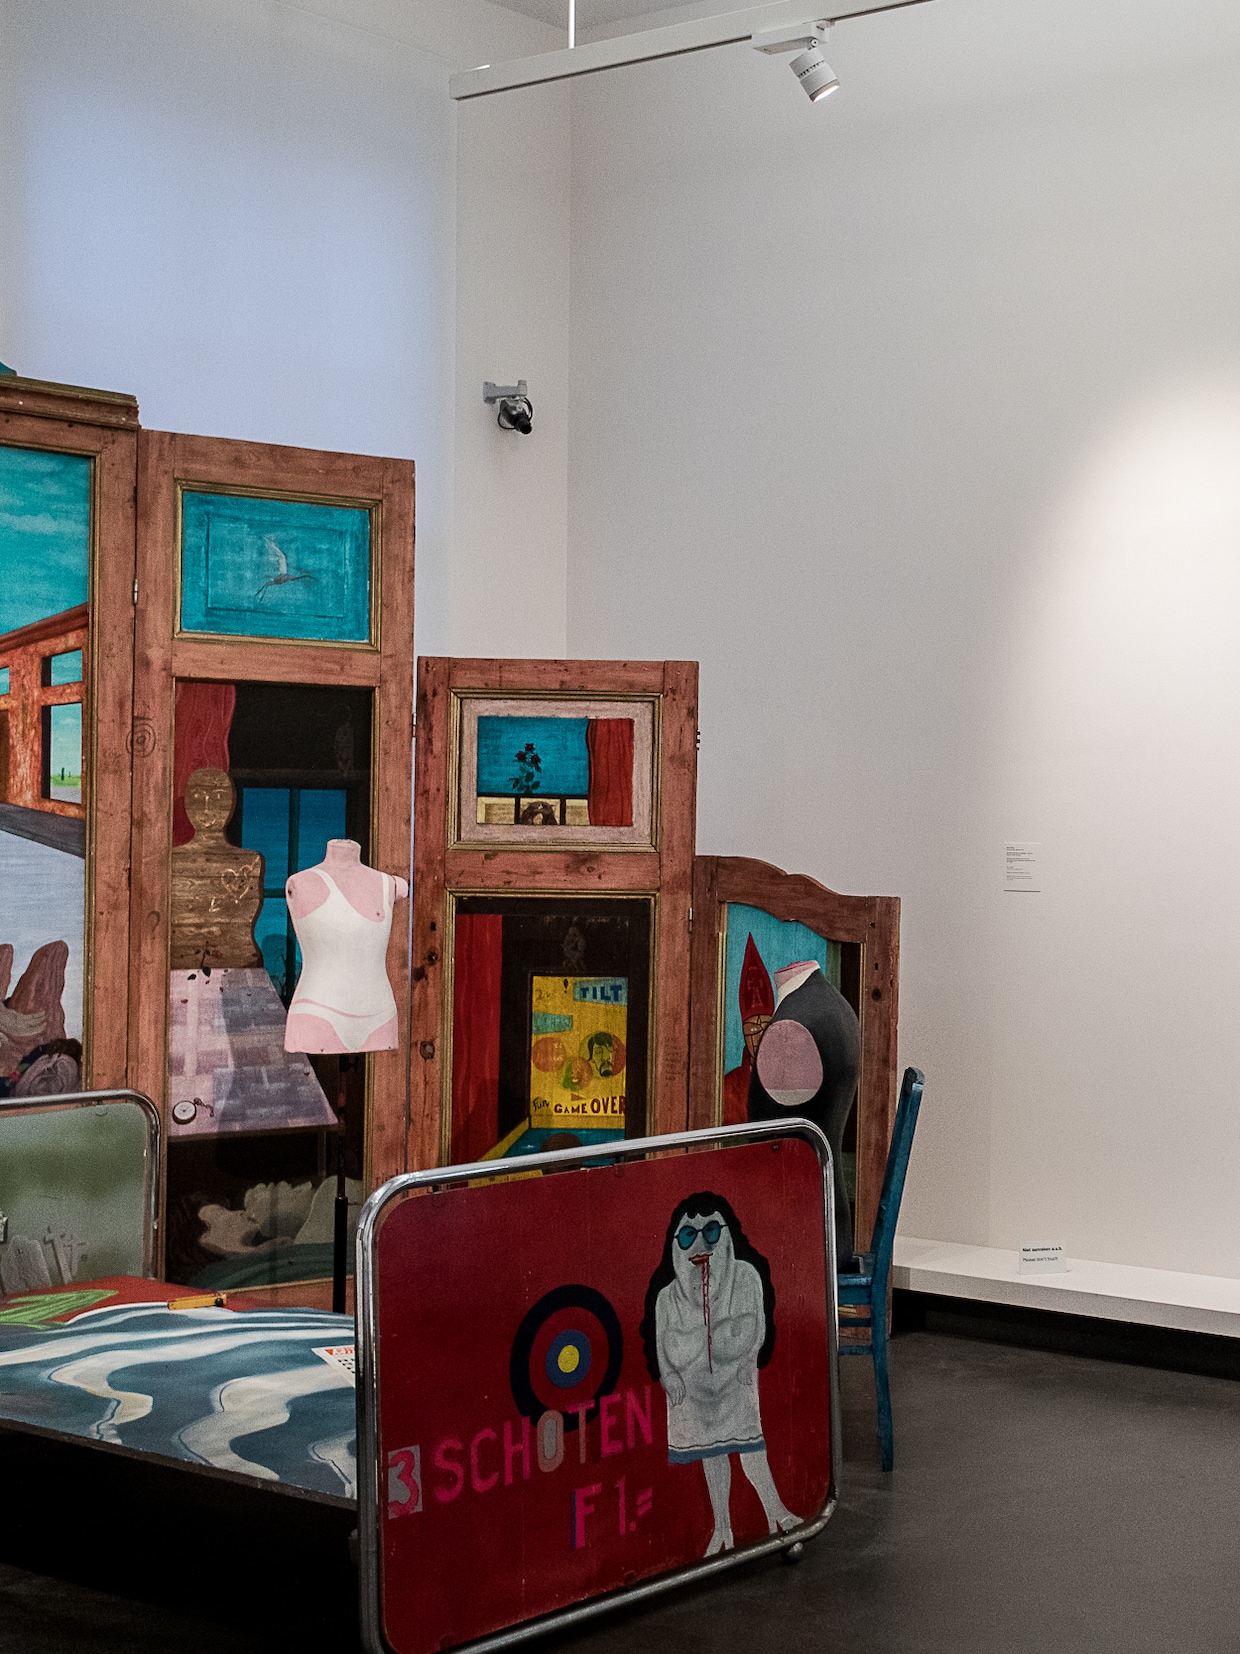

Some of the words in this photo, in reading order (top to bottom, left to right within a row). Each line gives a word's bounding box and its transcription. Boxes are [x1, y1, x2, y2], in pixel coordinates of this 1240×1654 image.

[580, 985, 622, 1002] TILT
[554, 1103, 588, 1114] GAME
[388, 1449, 420, 1517] 3
[433, 1385, 653, 1503] SCHOTEN
